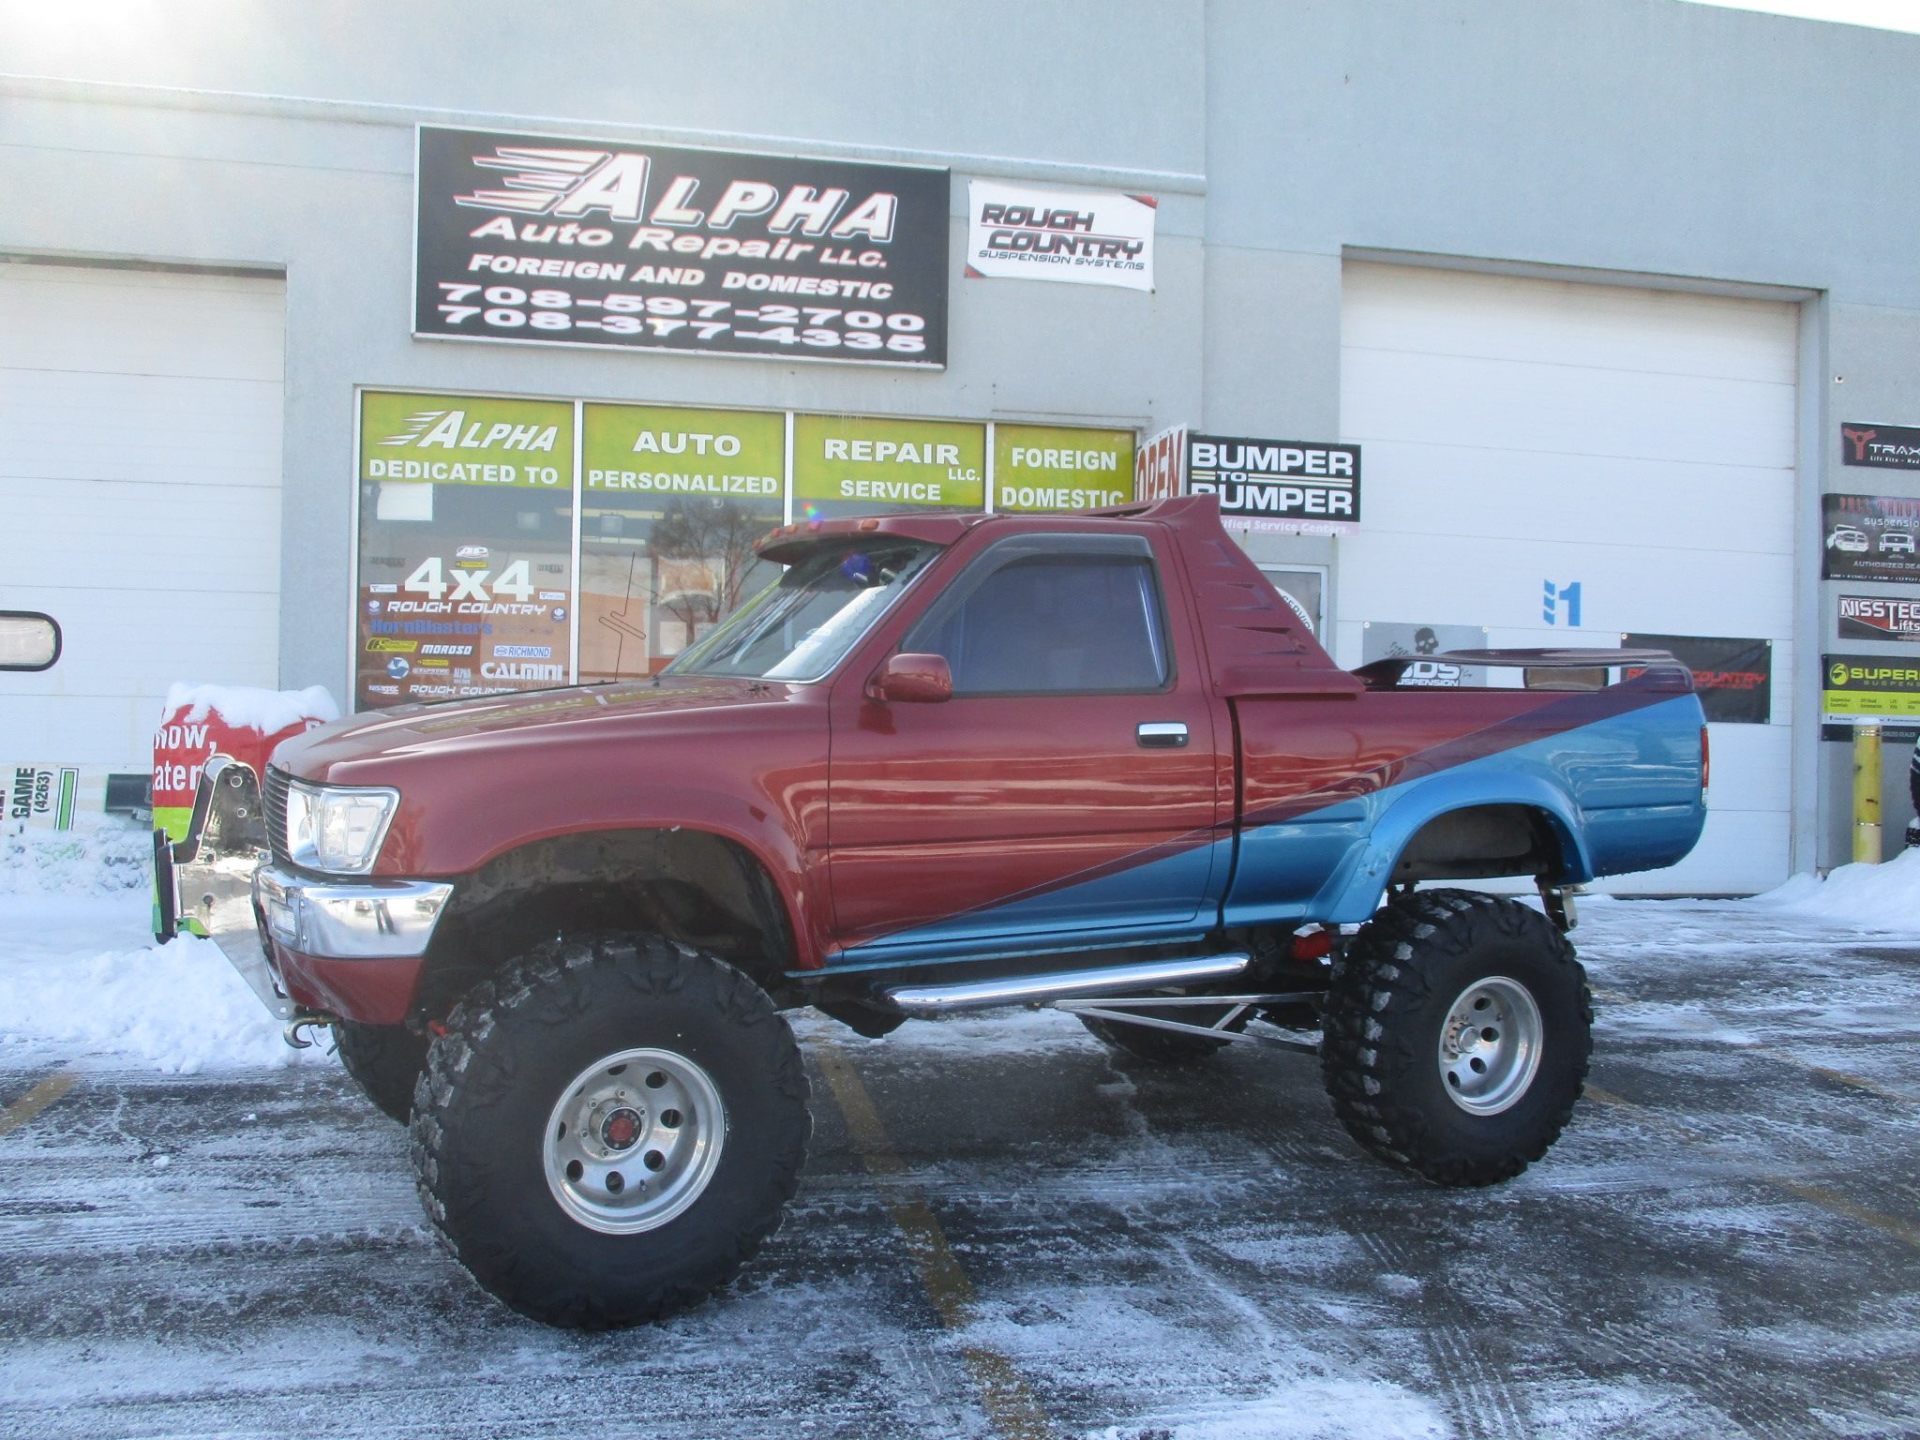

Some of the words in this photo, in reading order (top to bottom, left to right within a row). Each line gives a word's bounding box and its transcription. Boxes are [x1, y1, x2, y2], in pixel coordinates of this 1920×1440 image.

[553, 151, 897, 242] ALPHA
[980, 202, 1095, 232] ROUGH
[470, 216, 613, 246] Auto
[628, 227, 814, 260] Repair
[819, 247, 887, 268] LLC.
[987, 229, 1144, 260] COUNTRY
[978, 250, 1071, 264] SUSPENSION
[1074, 257, 1145, 271] SYSTEMS
[468, 254, 626, 280] FOREIGN
[629, 264, 705, 286] AND
[721, 271, 893, 300] DOMESTIC
[437, 283, 926, 332] 708-597-2700
[437, 305, 927, 352] 708-377-4335
[417, 410, 559, 452] ALPHA
[632, 431, 741, 456] AUTO
[824, 438, 960, 465] REPAIR
[948, 467, 981, 481] LLC.
[1011, 447, 1117, 471] FOREIGN
[1191, 442, 1353, 476] BUMPER
[1869, 443, 1920, 455] TRAX
[369, 458, 516, 483] DEDICATED
[524, 466, 558, 484] TO
[1136, 429, 1183, 501] OPEN
[1217, 471, 1247, 482] TO
[588, 470, 778, 494] PERSONALIZED
[840, 479, 942, 501] SERVICE
[1001, 486, 1124, 508] DOMESTIC
[405, 557, 535, 602] 4x4
[387, 601, 452, 613] ROUGH
[458, 602, 547, 616] COUNTRY
[1559, 582, 1581, 627] 1
[508, 647, 550, 658] RICHMOND
[480, 661, 563, 681] CALMINI
[409, 684, 455, 695] ROUGH
[33, 771, 54, 814] (4263)
